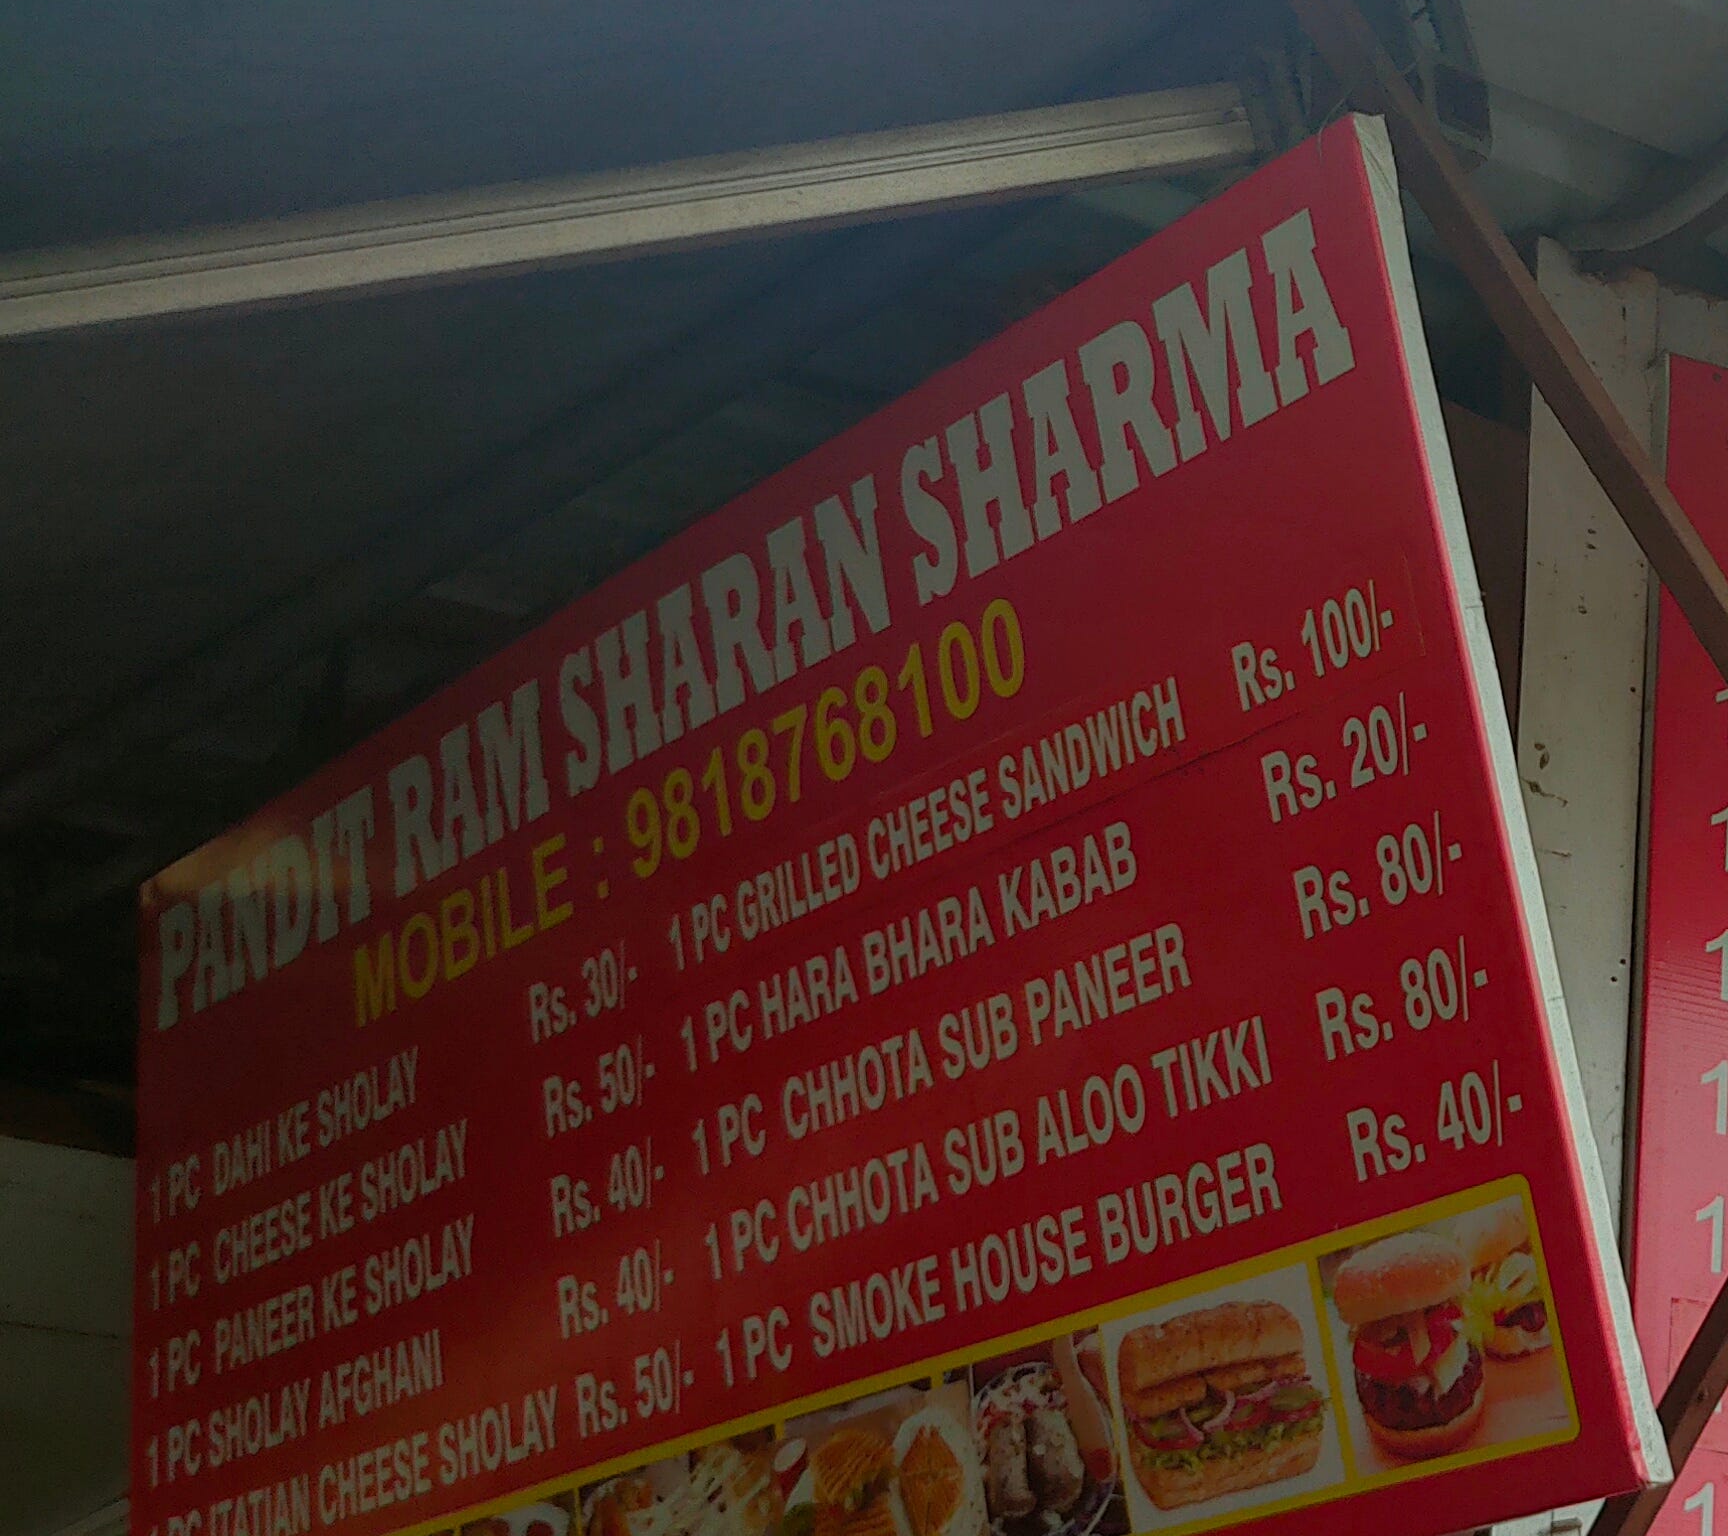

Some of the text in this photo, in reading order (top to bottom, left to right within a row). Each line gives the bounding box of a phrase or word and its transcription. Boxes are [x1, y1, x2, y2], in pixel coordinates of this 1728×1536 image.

[157, 208, 1354, 1030] PANDIT RAM SHARAN SHARMA
[1231, 579, 1393, 711] Rs. 100/-
[352, 597, 1023, 1026] MOBILE : 9818768100
[667, 677, 1184, 970] 1 PC GRILLED CHEESE SANDWICH
[1261, 692, 1427, 822] Rs. 20/-
[1293, 811, 1461, 938] Rs. 80/-
[528, 942, 637, 1043] Rs. 30/-
[680, 821, 1136, 1072] 1 PC HARA BHARA KABAB
[1316, 936, 1487, 1060] Rs. 80/-
[543, 1036, 655, 1137] Rs. 50/-
[692, 923, 1189, 1174] 1 PC CHHOTA SUB PANEER
[1701, 1061, 1728, 1134] 1
[149, 1047, 417, 1224] 1 PC DAHI KE SHOLAY
[550, 1137, 664, 1237] Rs. 40/-
[704, 1016, 1271, 1280] 1 PC CHHOTA SUB ALOO TIKKI
[1346, 1060, 1522, 1181] Rs. 40/-
[149, 1118, 466, 1309] 1 PC CHEESE KE SHOLAY
[715, 1143, 1281, 1387] 1 PC SMOKE HOUSE BURGER
[1696, 1196, 1724, 1274] 1
[147, 1214, 473, 1398] 1 PC PANEER KE SHOLAY
[558, 1240, 674, 1338] Rs. 40/-
[146, 1329, 442, 1487] 1 PC SHOLAY AFGHANI
[318, 1432, 431, 1525] CHEESE
[438, 1386, 556, 1485] SHOLAY
[575, 1340, 694, 1437] Rs. 50/-
